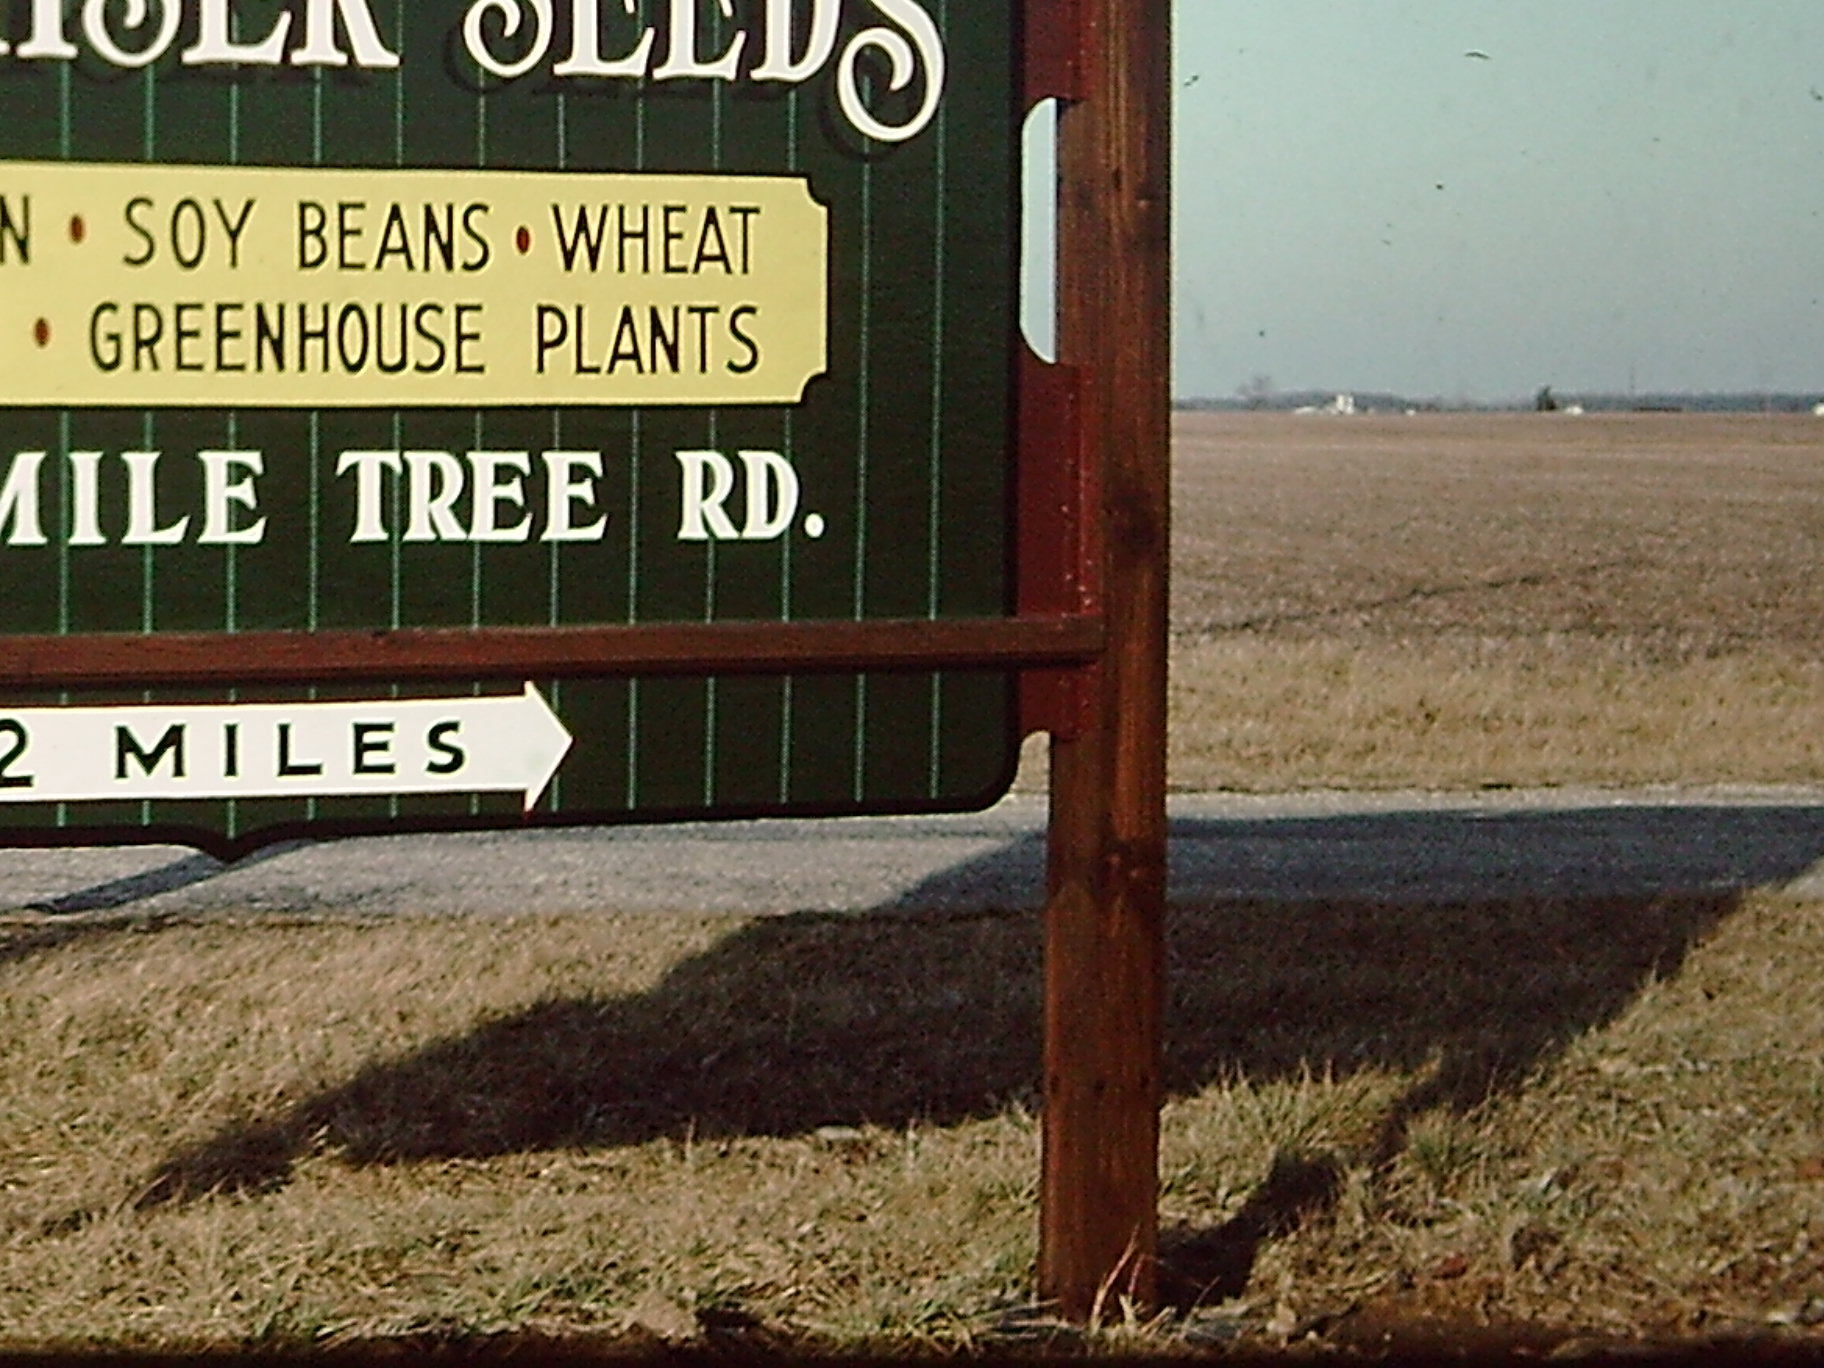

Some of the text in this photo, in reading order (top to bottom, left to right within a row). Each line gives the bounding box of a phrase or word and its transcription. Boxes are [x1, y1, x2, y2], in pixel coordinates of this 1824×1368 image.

[123, 198, 255, 269] SOY
[298, 201, 491, 273] BEANS
[552, 203, 762, 274] WHEAT
[90, 303, 485, 374] GREENHOUSE
[536, 305, 760, 375] PLANTS
[337, 451, 606, 541] TREE
[676, 451, 824, 539] RD.
[115, 722, 465, 778] MILES
